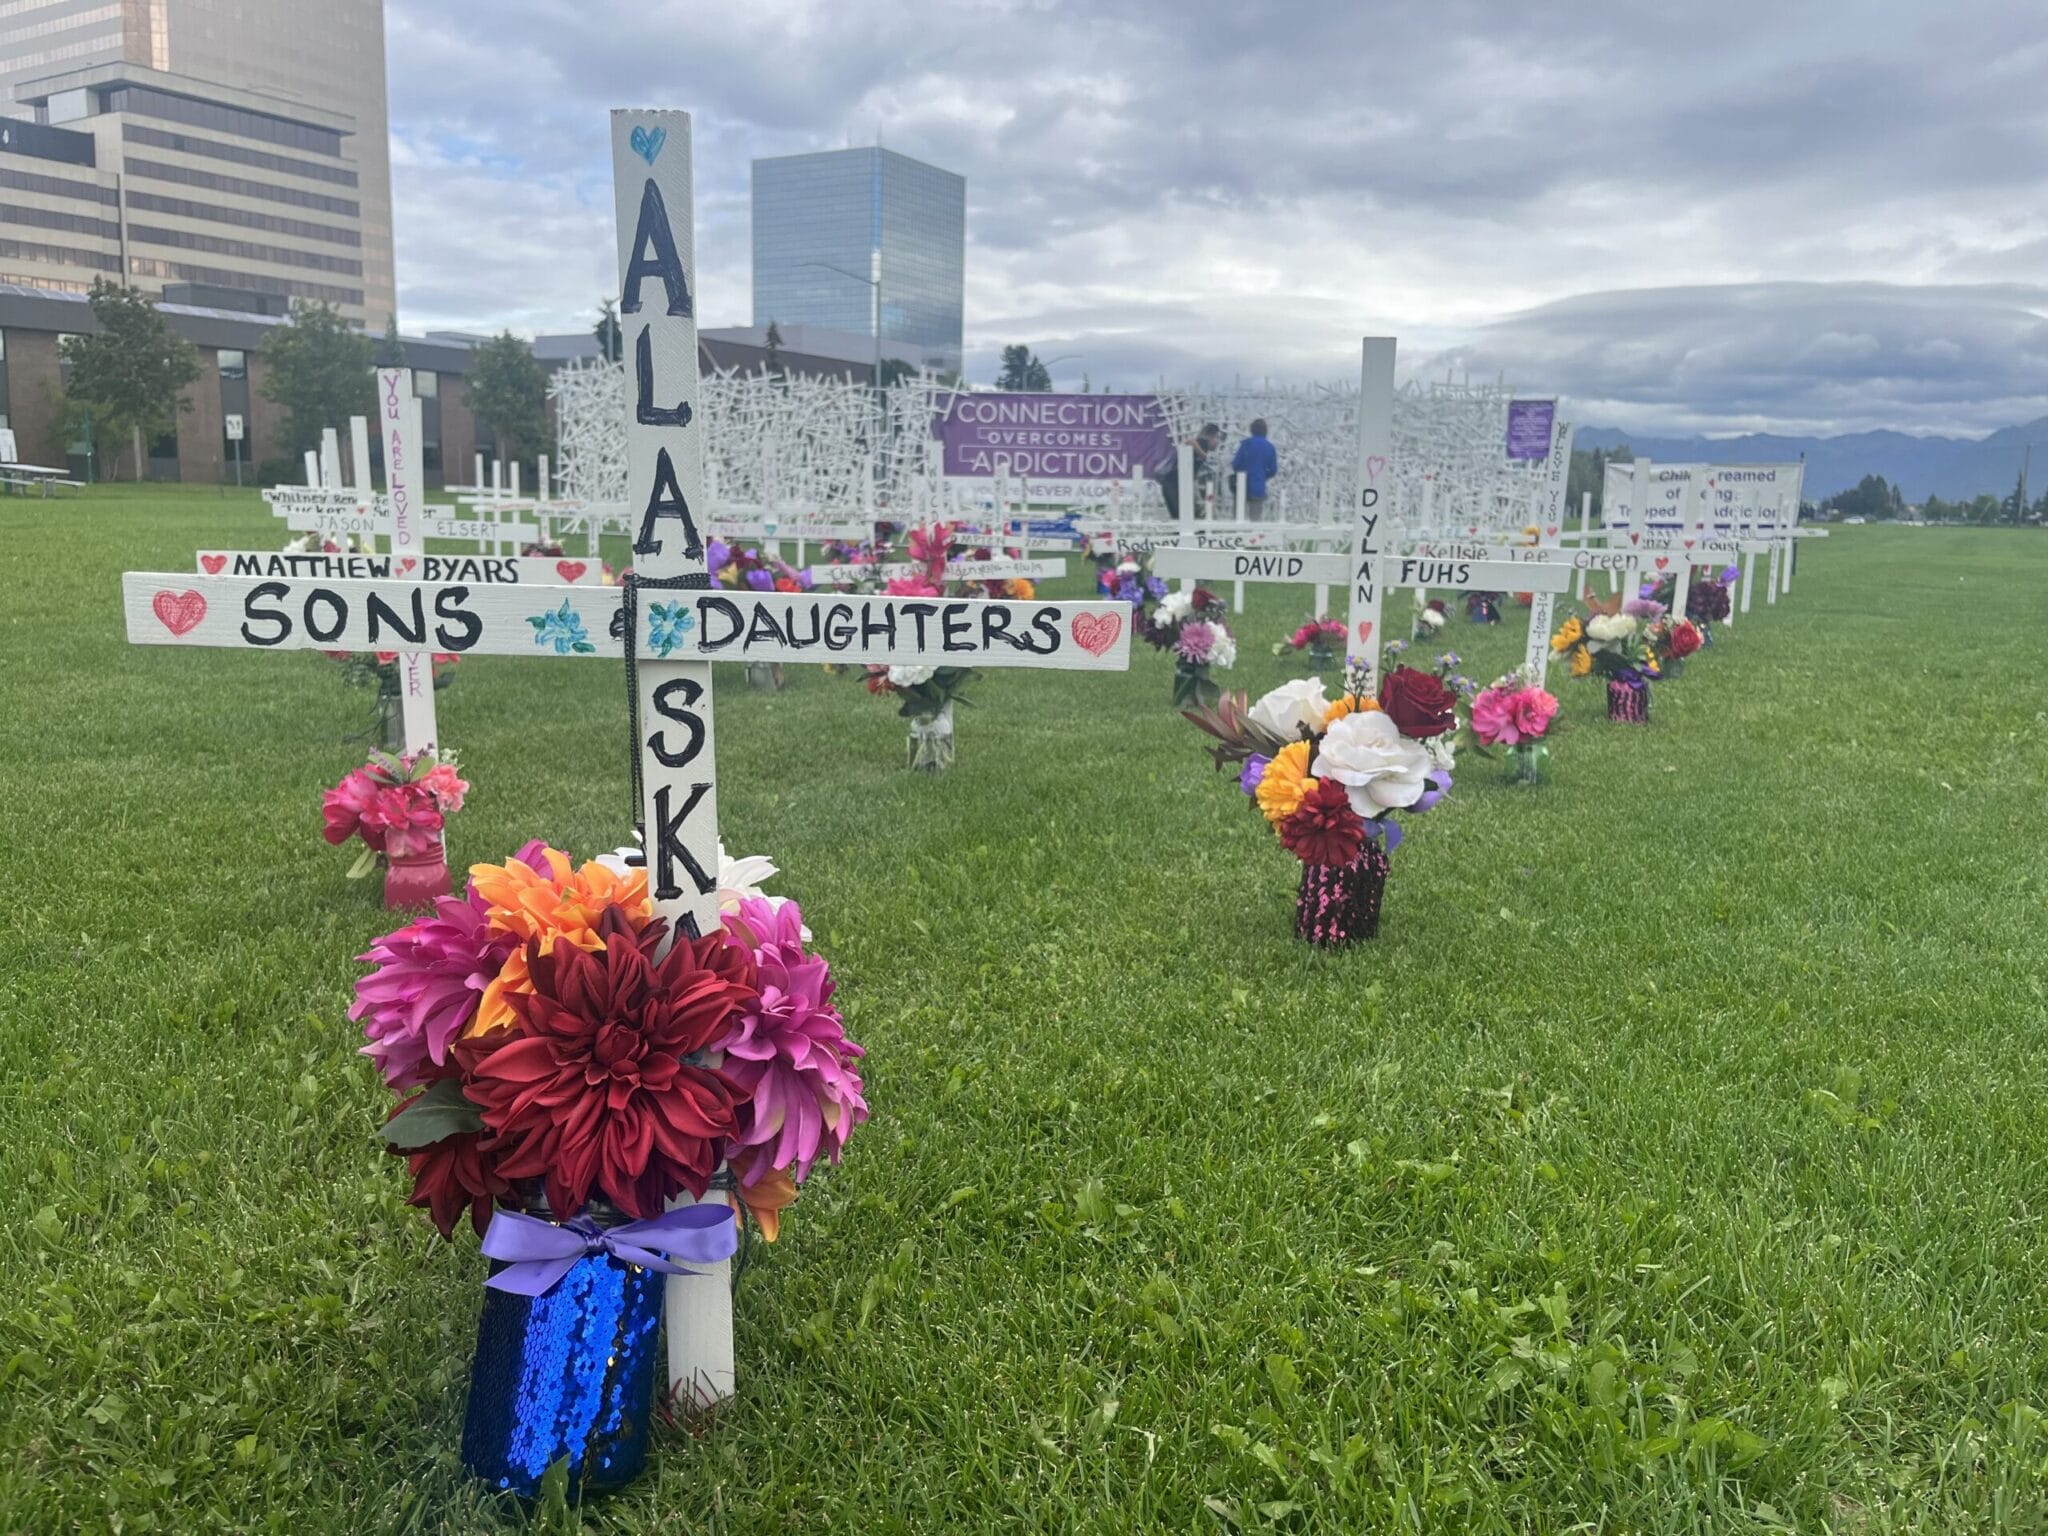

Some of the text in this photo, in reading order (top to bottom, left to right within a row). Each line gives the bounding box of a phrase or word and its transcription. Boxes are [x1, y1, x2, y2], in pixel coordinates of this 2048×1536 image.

[957, 401, 1144, 426] CONNECTION
[391, 429, 404, 471] ARE
[987, 431, 1113, 447] OVERCOMES
[972, 451, 1128, 475] ADDICTION
[1717, 470, 1777, 482] reamed
[1665, 487, 1682, 500] of
[391, 473, 411, 545] LOVED
[315, 516, 499, 538] JASON EISERT
[1197, 535, 1244, 549] Price
[1356, 488, 1378, 603] DYLAN
[233, 555, 519, 584] MATTHEW BYARS
[622, 178, 717, 940] ALASK
[1235, 555, 1470, 584] DAVID FUHS
[1423, 543, 1488, 561] Kellsie
[1574, 551, 1639, 570] Green
[241, 581, 483, 652] SONS
[697, 596, 1062, 655] DAUGHTERS
